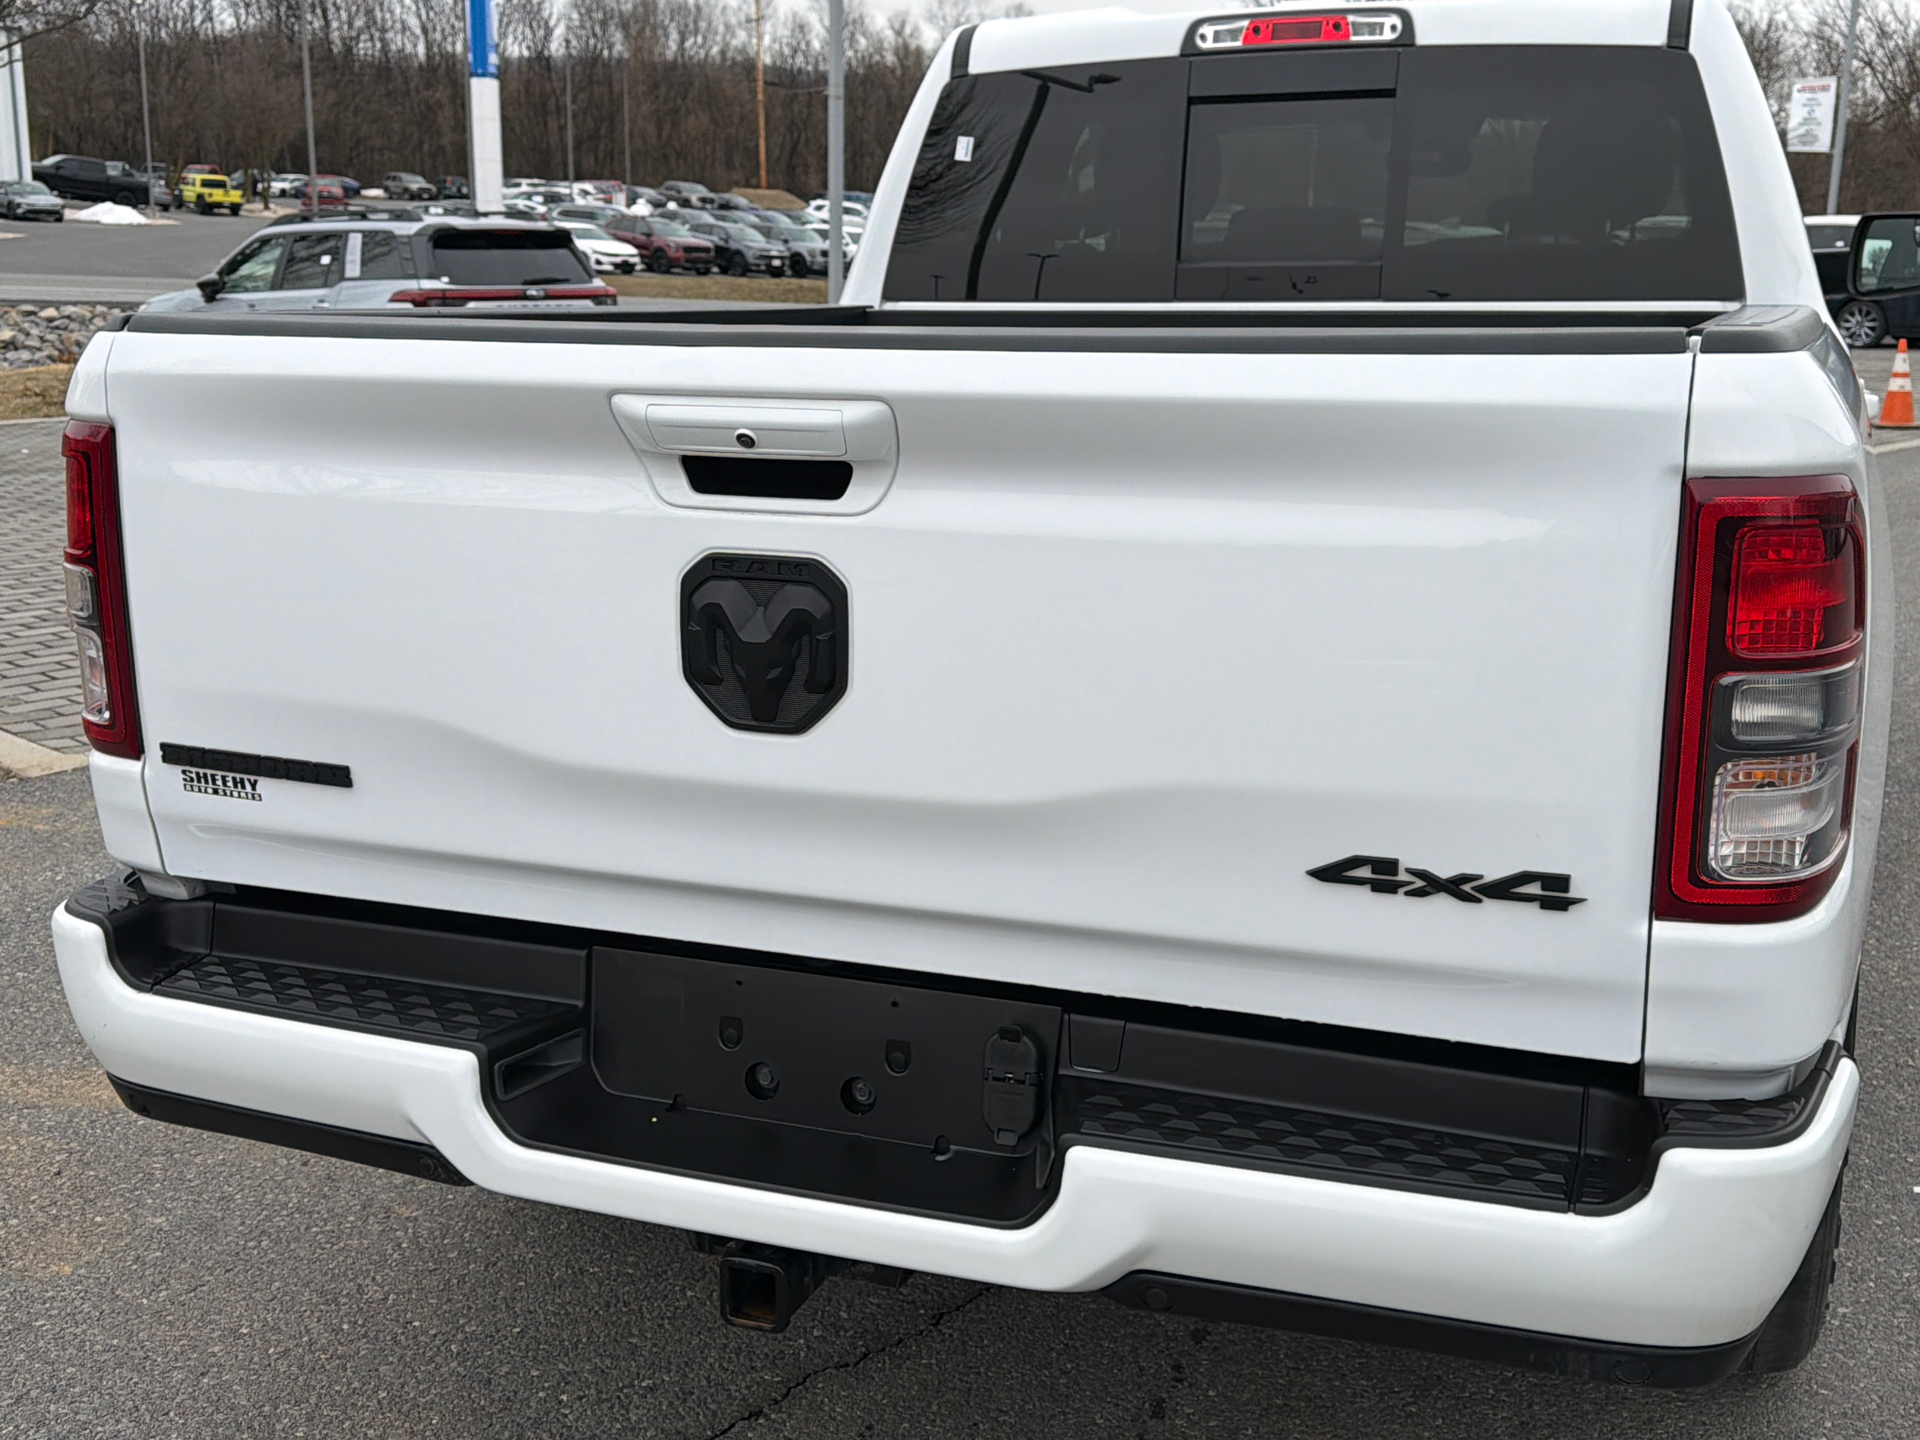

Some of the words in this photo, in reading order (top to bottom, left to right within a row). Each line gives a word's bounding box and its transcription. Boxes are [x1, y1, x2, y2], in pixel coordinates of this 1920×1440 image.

[711, 558, 811, 578] RAM
[181, 769, 259, 792] SHEEHY
[185, 784, 214, 795] AUTO
[217, 788, 261, 801] STORES
